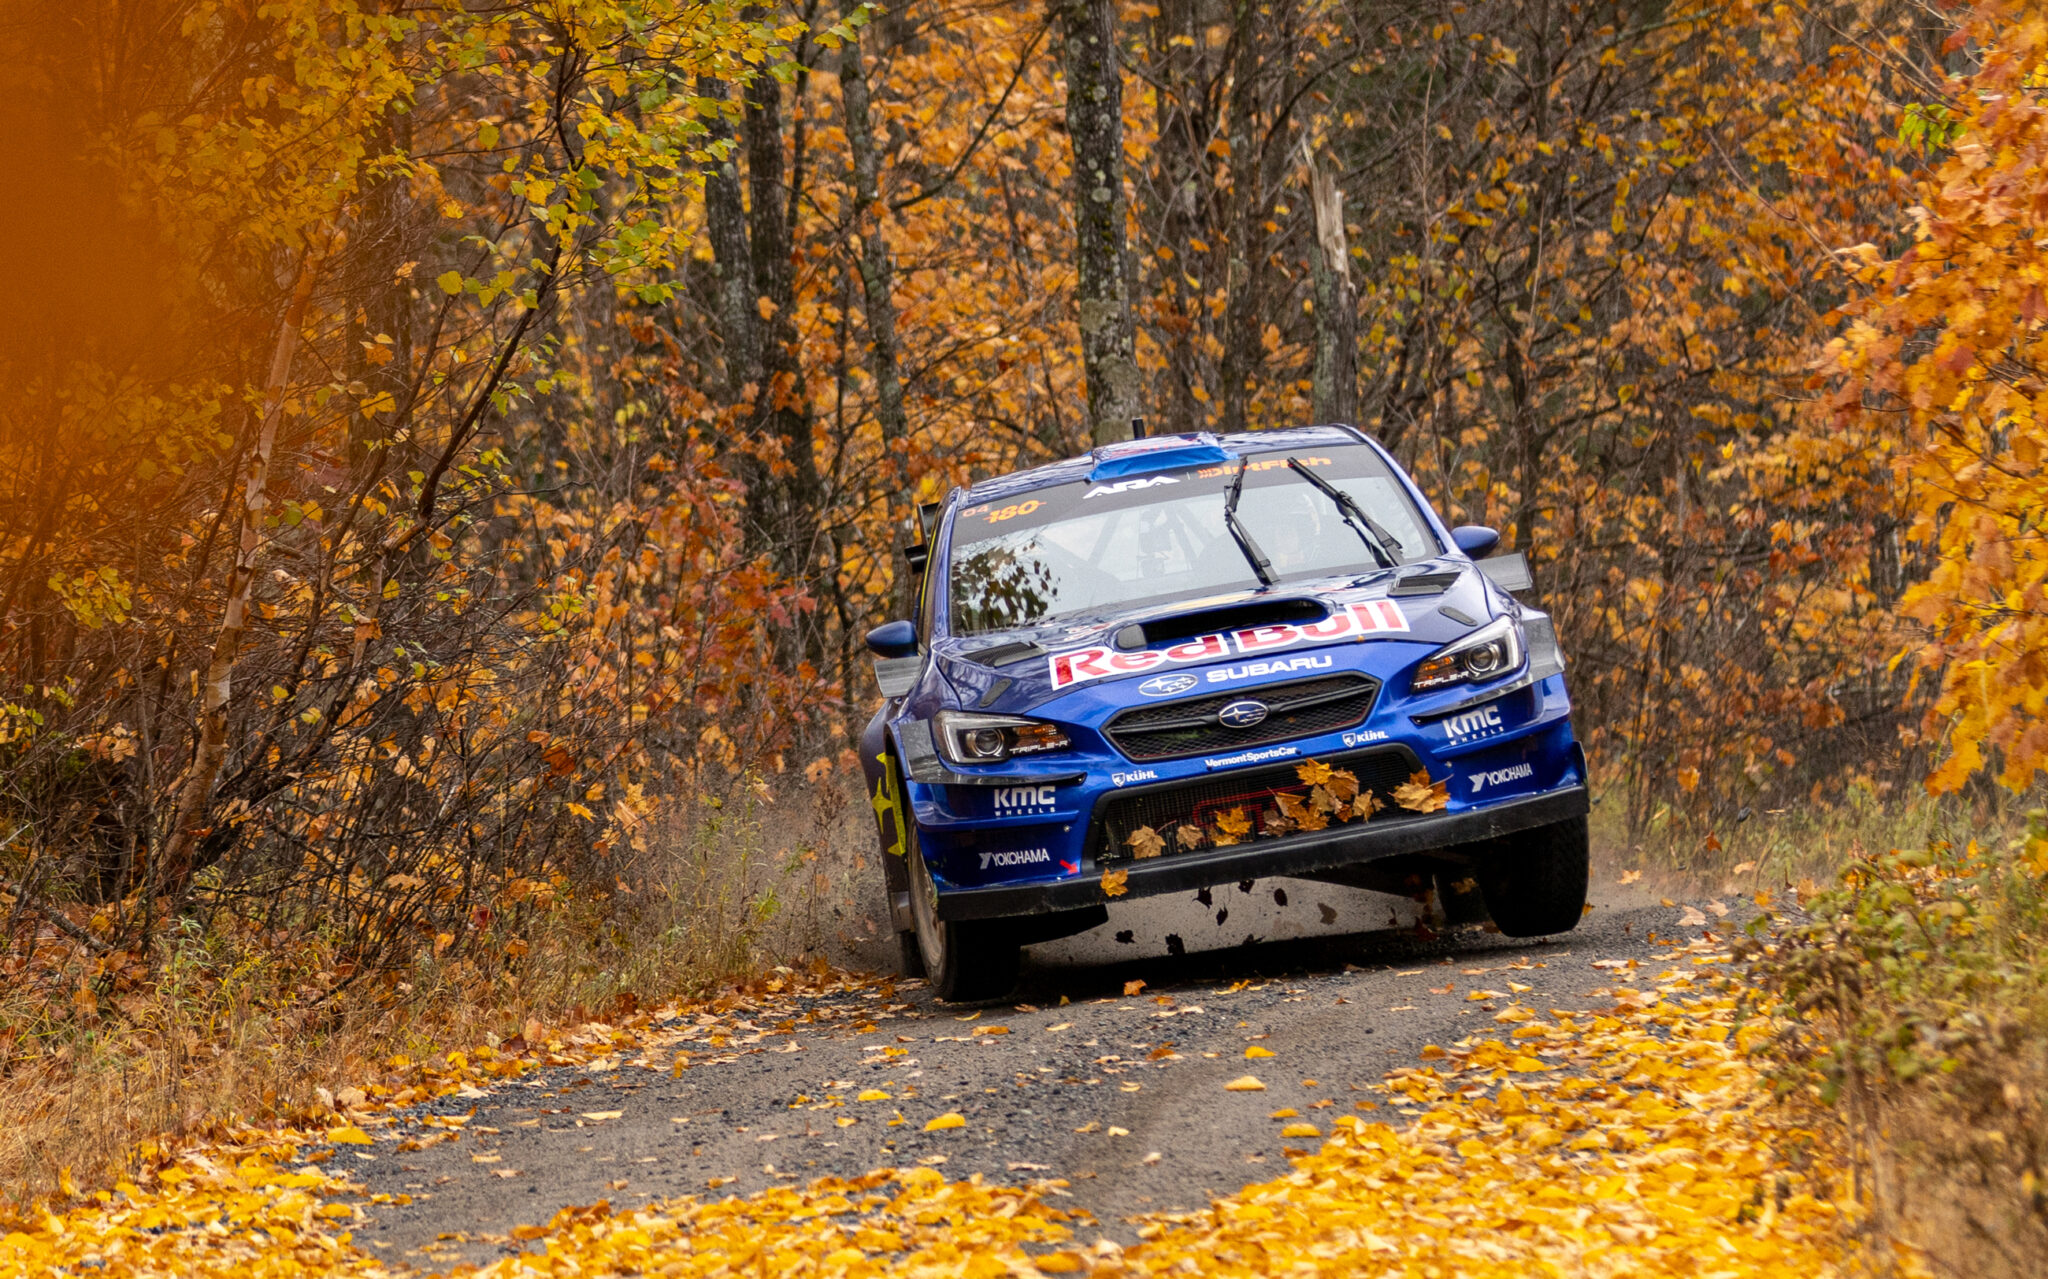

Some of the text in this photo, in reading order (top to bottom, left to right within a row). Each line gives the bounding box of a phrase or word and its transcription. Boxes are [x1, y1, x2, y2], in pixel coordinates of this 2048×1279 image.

[1082, 476, 1180, 499] ARA
[988, 500, 1040, 524] 180
[1053, 601, 1403, 686] Red Bull
[1206, 656, 1332, 683] SUBARU
[1414, 671, 1469, 689] TRIPLE-R
[1009, 738, 1069, 753] TRIPLE-R
[1357, 730, 1388, 743] KÜHL
[1450, 726, 1504, 746] WHEELS
[1204, 746, 1297, 768] VermontSportsCar
[1126, 769, 1158, 782] KÜHL
[1487, 763, 1533, 786] YOKOHAMA
[994, 807, 1056, 816] WHEELS
[992, 848, 1050, 866] YOKOHAMA
